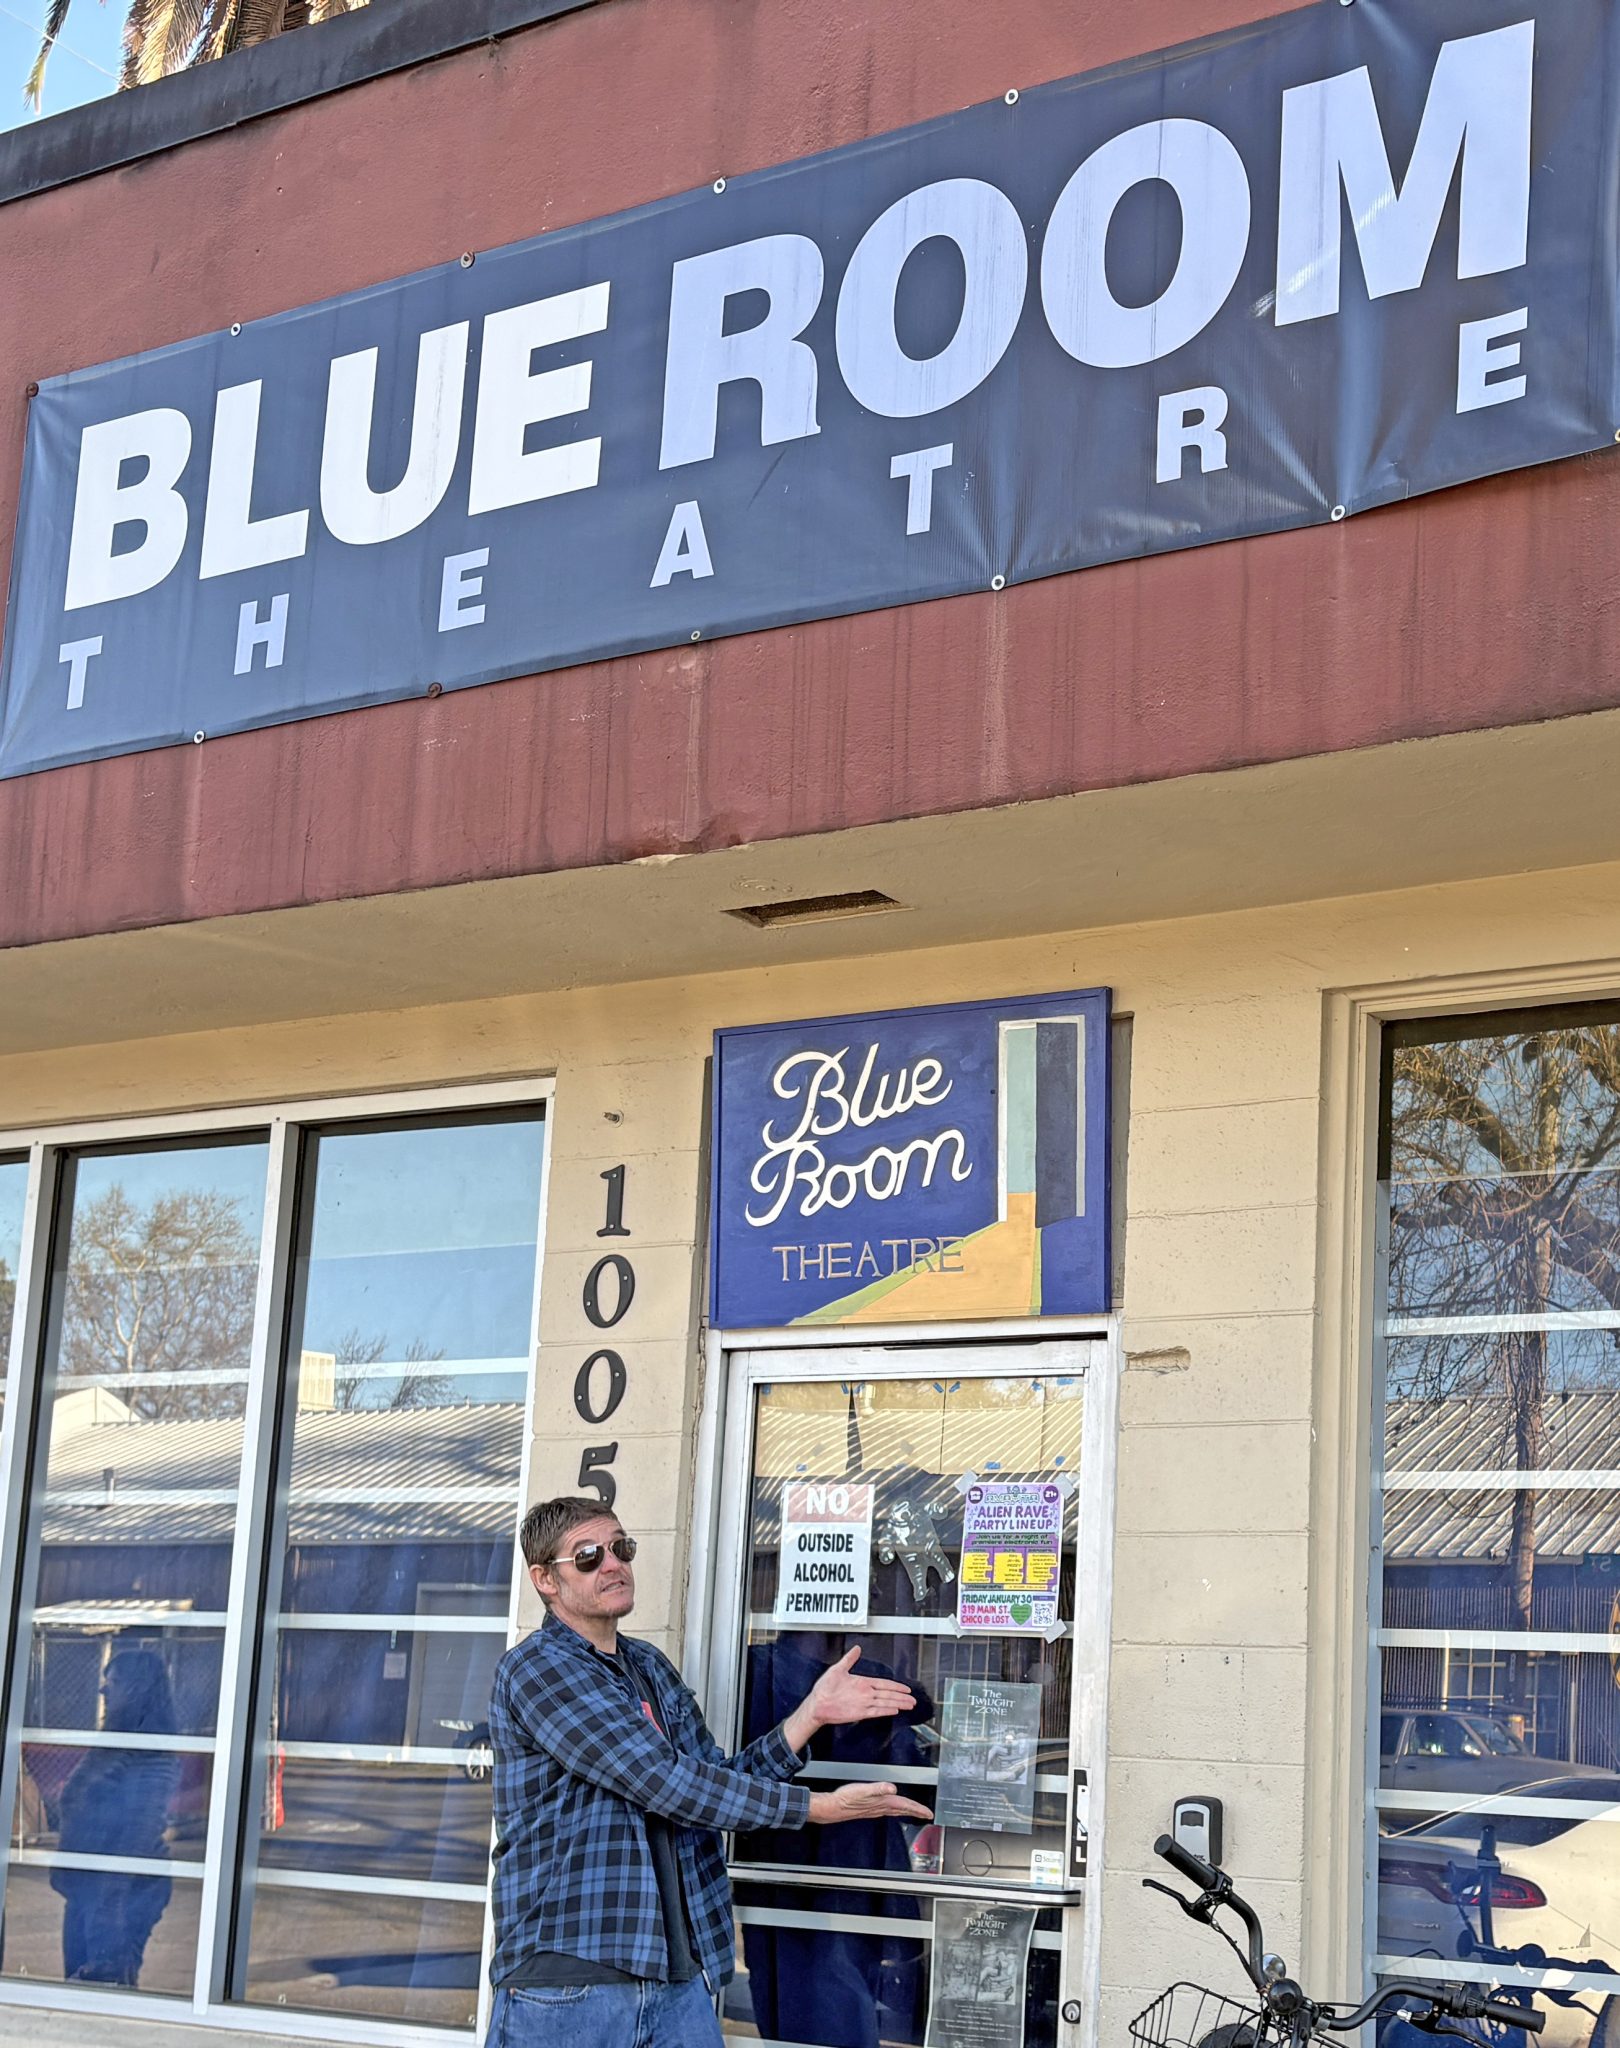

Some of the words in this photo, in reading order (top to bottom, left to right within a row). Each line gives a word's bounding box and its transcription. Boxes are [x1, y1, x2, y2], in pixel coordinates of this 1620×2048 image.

[63, 281, 612, 613] BLUE
[658, 18, 1536, 471] ROOM
[58, 307, 1529, 711] THEATRE
[762, 1043, 953, 1150] Blue
[744, 1129, 973, 1227] Room
[772, 1236, 966, 1282] THEATRE
[806, 1487, 849, 1515] NO
[977, 1505, 1012, 1518] ALIEN
[1015, 1505, 1050, 1518] RAVE
[973, 1519, 1007, 1530] PARTY
[1009, 1519, 1053, 1530] LINEUP
[797, 1533, 854, 1552] OUTSIDE
[793, 1563, 855, 1583] ALCOHOL
[785, 1593, 859, 1613] PERMITTED
[961, 1594, 987, 1604] FRIDAY
[988, 1594, 1019, 1604] JANUARY
[1020, 1594, 1032, 1603] 30
[961, 1605, 975, 1614] 319
[977, 1605, 996, 1614] MAIN
[998, 1605, 1010, 1614] ST.
[961, 1616, 982, 1624] CHICO
[992, 1616, 1010, 1624] LOST
[982, 1688, 1002, 1698] The
[975, 1705, 1007, 1716] ZONE
[976, 1911, 994, 1920] The
